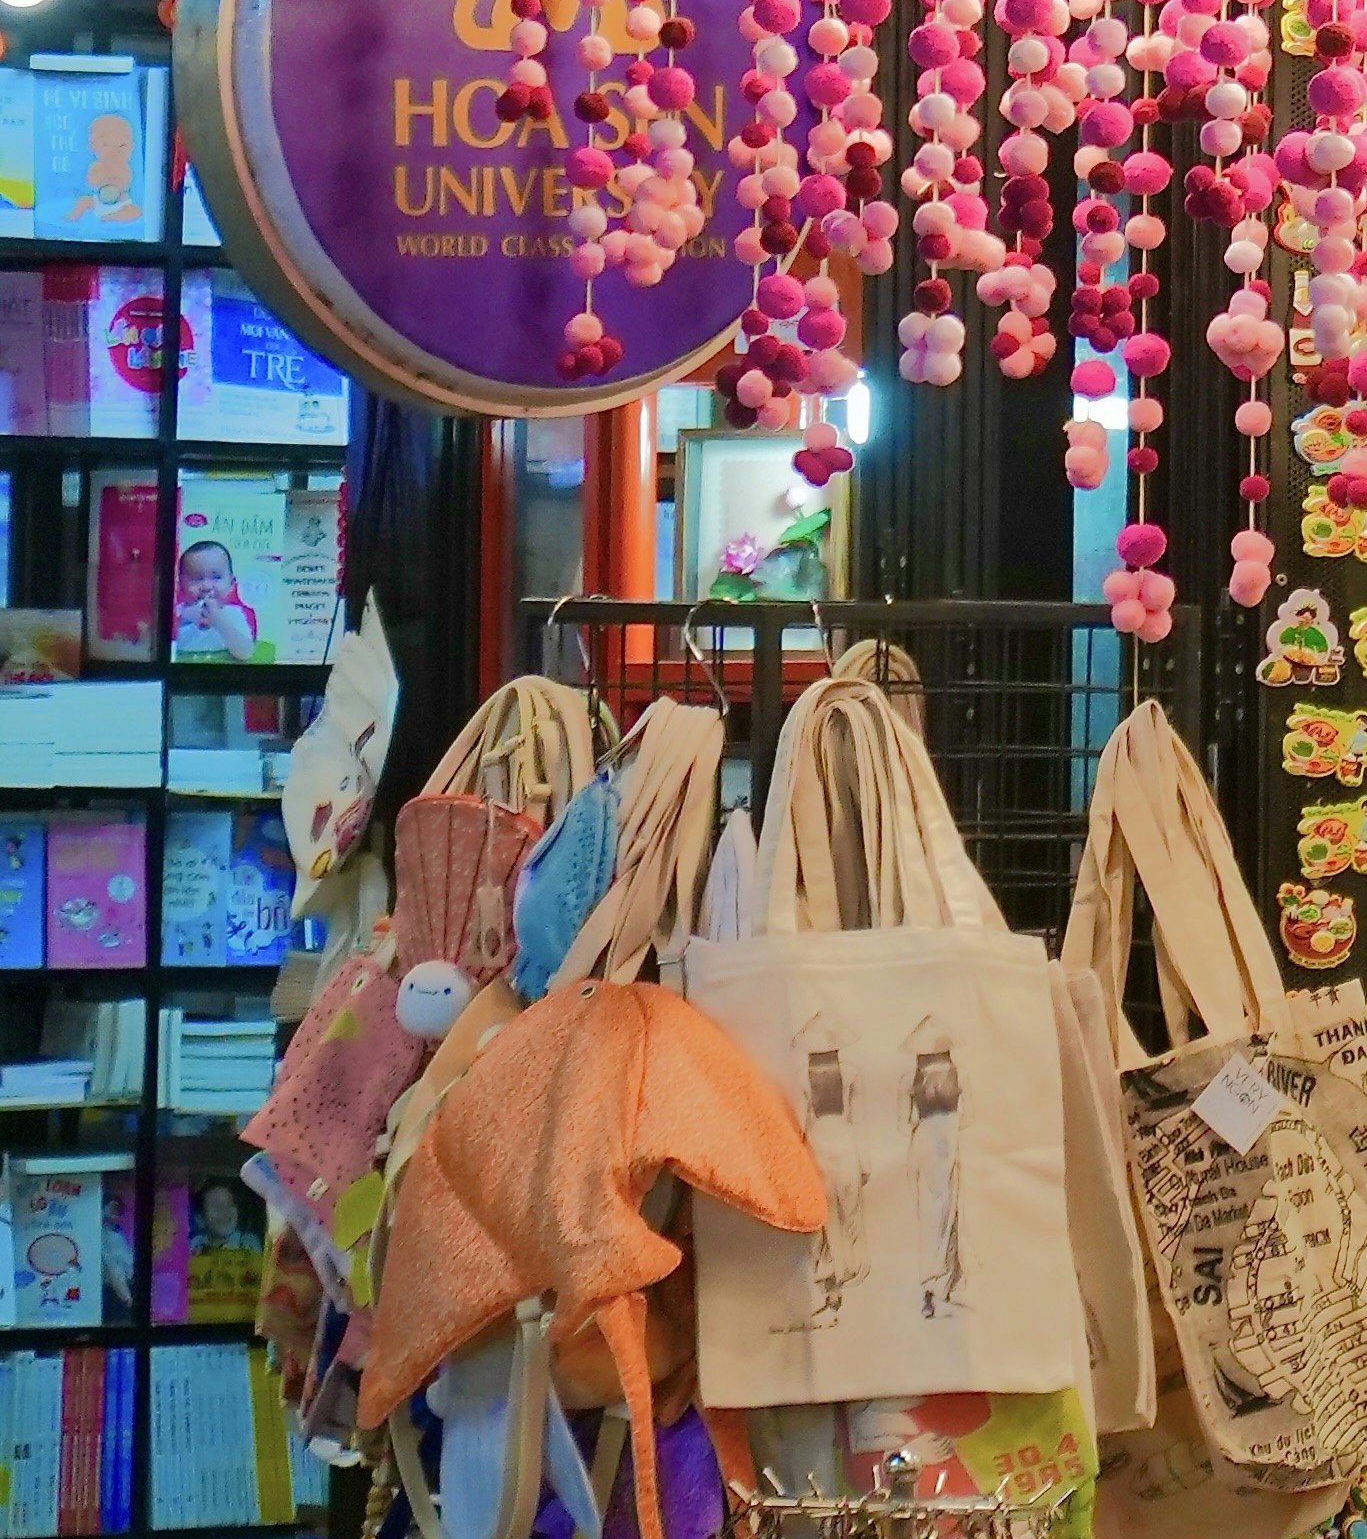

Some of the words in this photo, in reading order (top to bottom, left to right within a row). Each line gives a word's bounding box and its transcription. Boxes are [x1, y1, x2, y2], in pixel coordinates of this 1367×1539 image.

[397, 235, 489, 258] WORLD
[501, 235, 575, 258] CLASS
[1192, 1246, 1224, 1307] SAI
